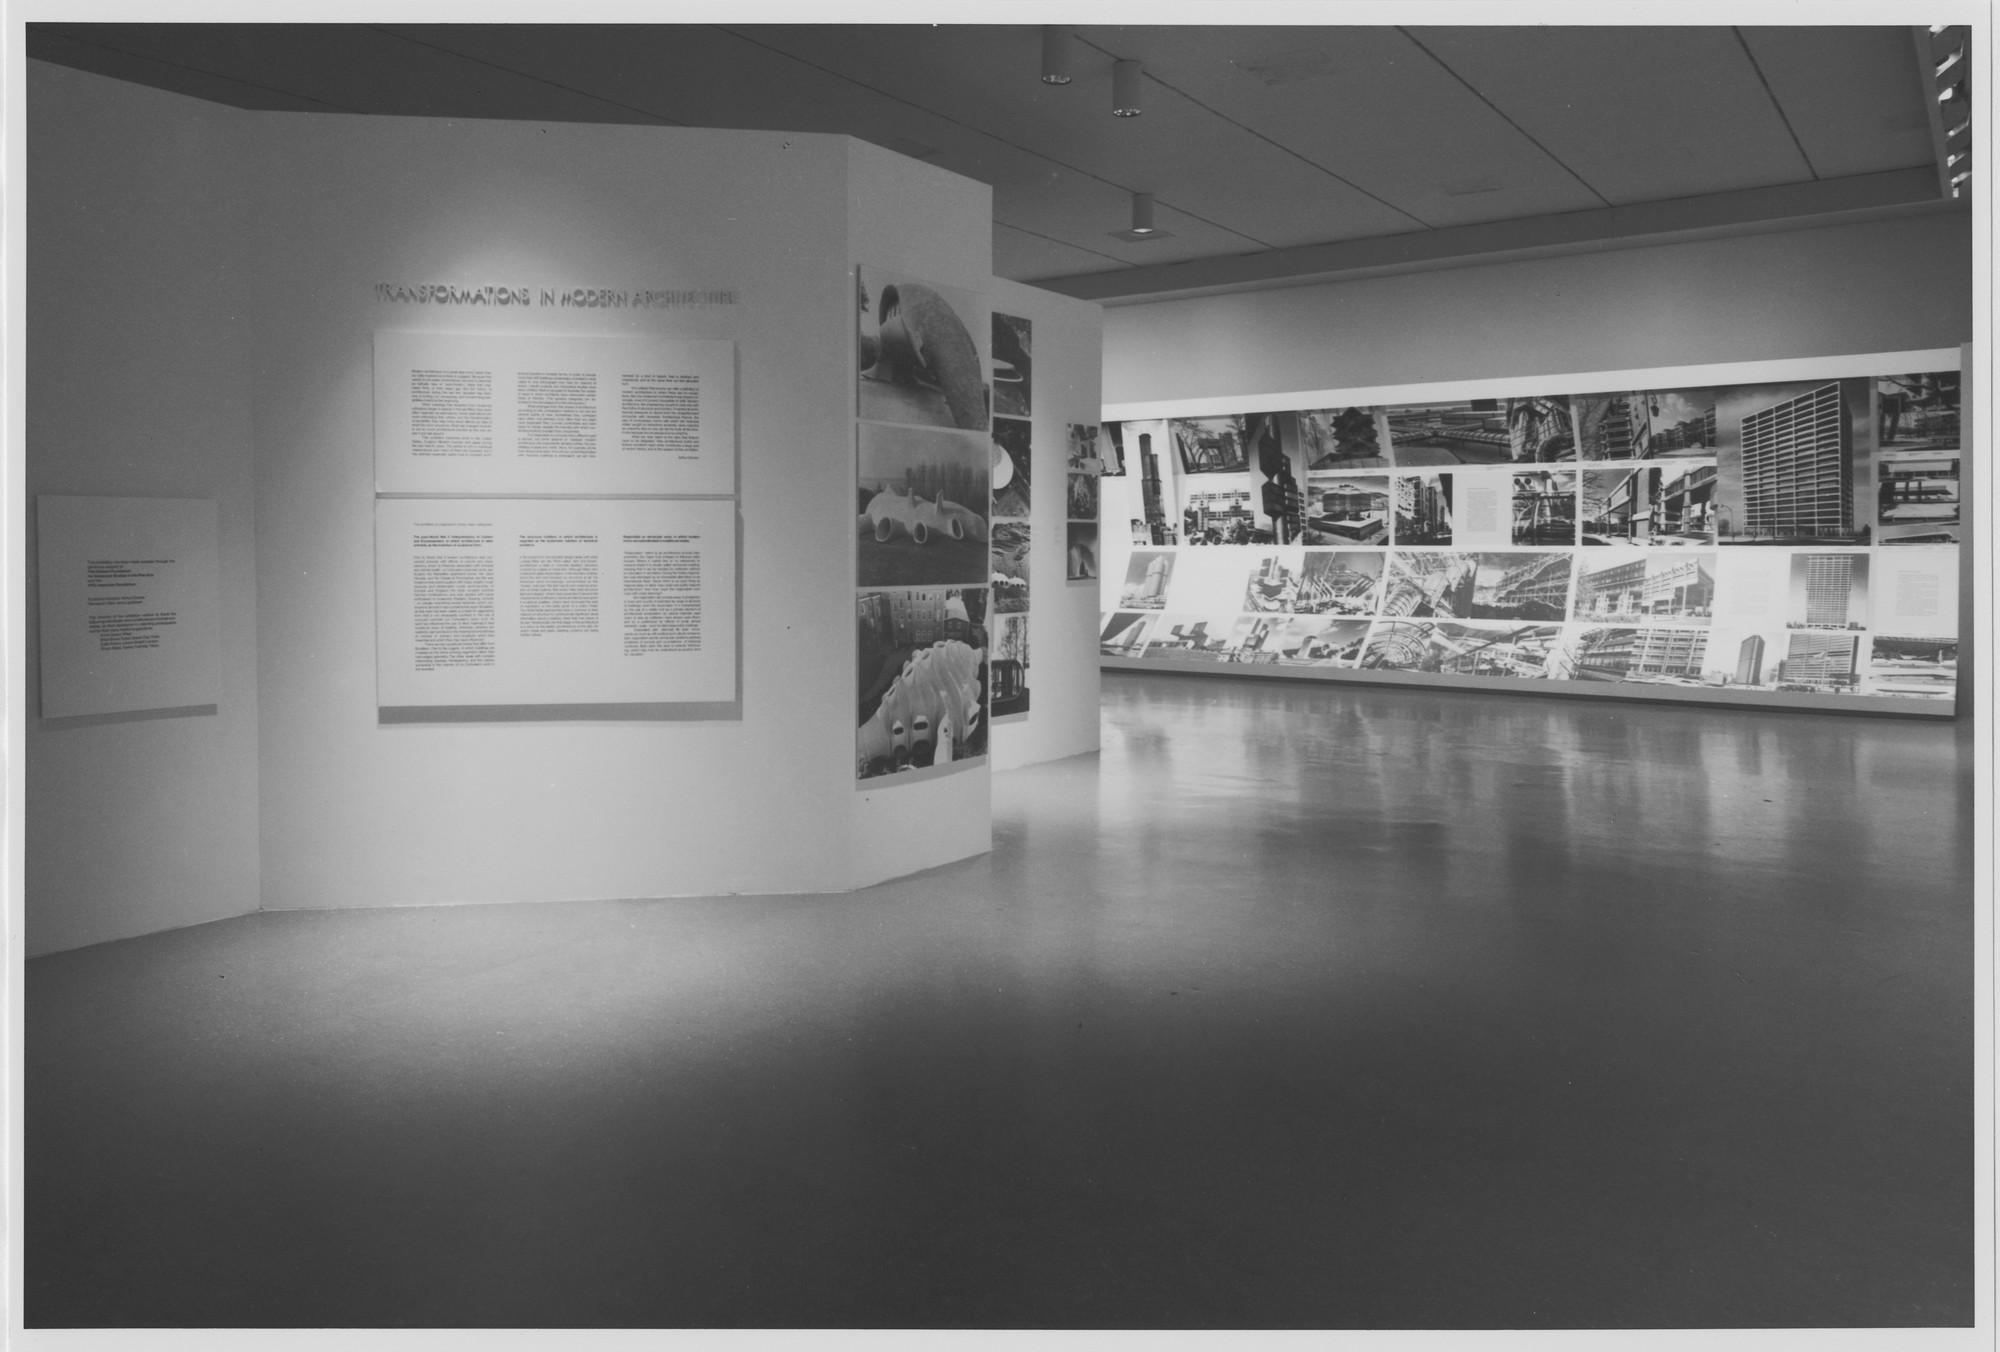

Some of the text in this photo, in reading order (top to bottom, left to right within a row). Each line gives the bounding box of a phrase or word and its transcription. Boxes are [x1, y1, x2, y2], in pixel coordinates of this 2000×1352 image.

[374, 281, 530, 306] TRANSFORMATIONS
[540, 287, 555, 307] IN
[561, 288, 628, 309] MODERN
